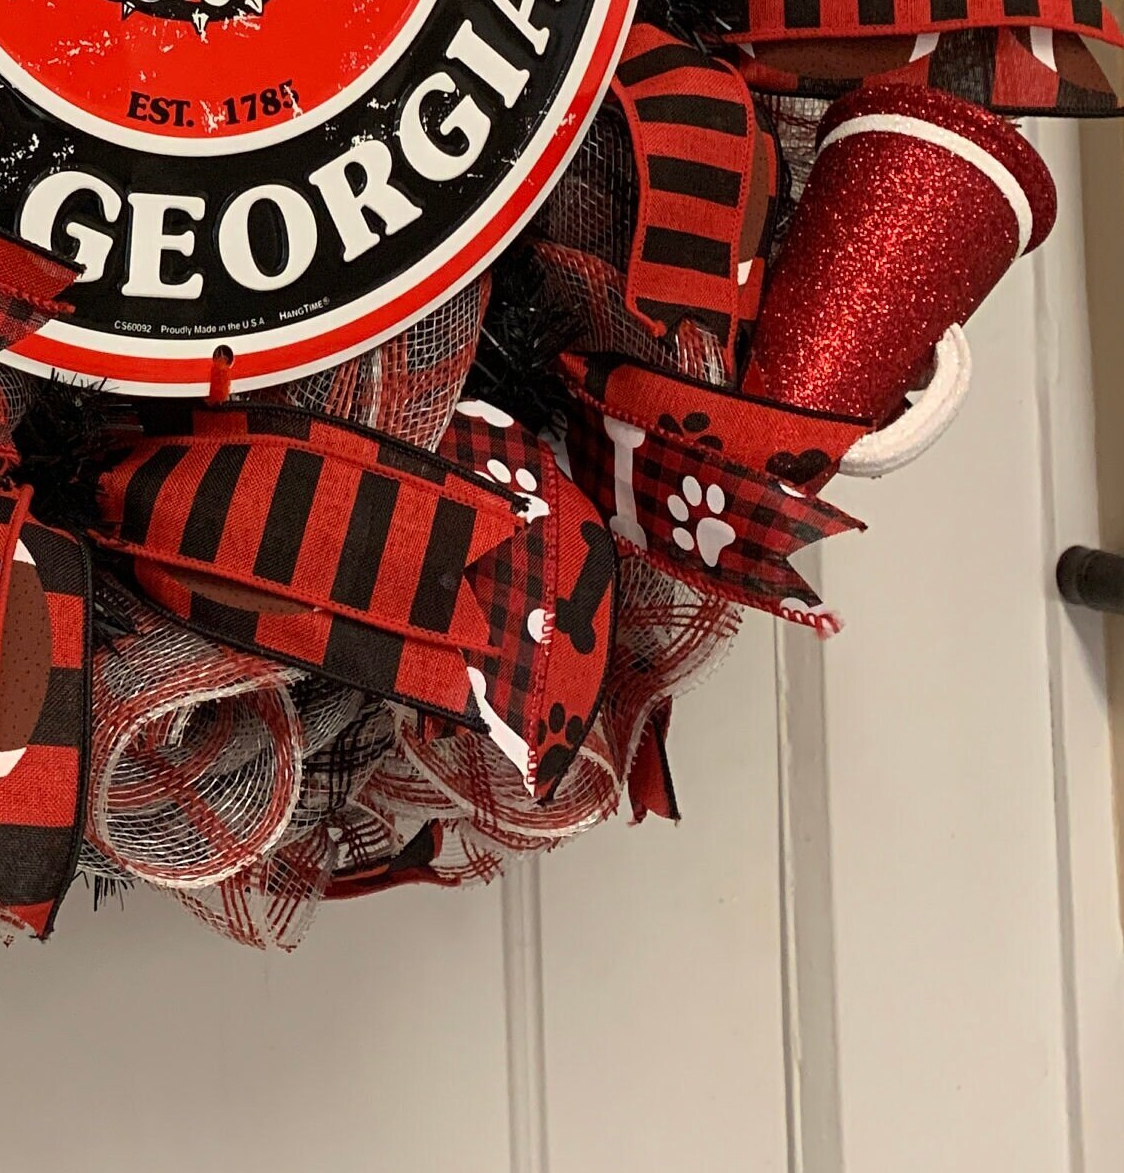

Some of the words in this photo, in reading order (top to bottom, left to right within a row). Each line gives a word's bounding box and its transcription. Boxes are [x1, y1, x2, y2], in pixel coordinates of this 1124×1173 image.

[127, 91, 194, 127] EST.
[224, 79, 299, 125] 1785
[114, 320, 152, 333] CS60092
[161, 325, 192, 336] Proudly
[194, 325, 216, 334] Made
[218, 324, 226, 332] in
[228, 322, 240, 331] the
